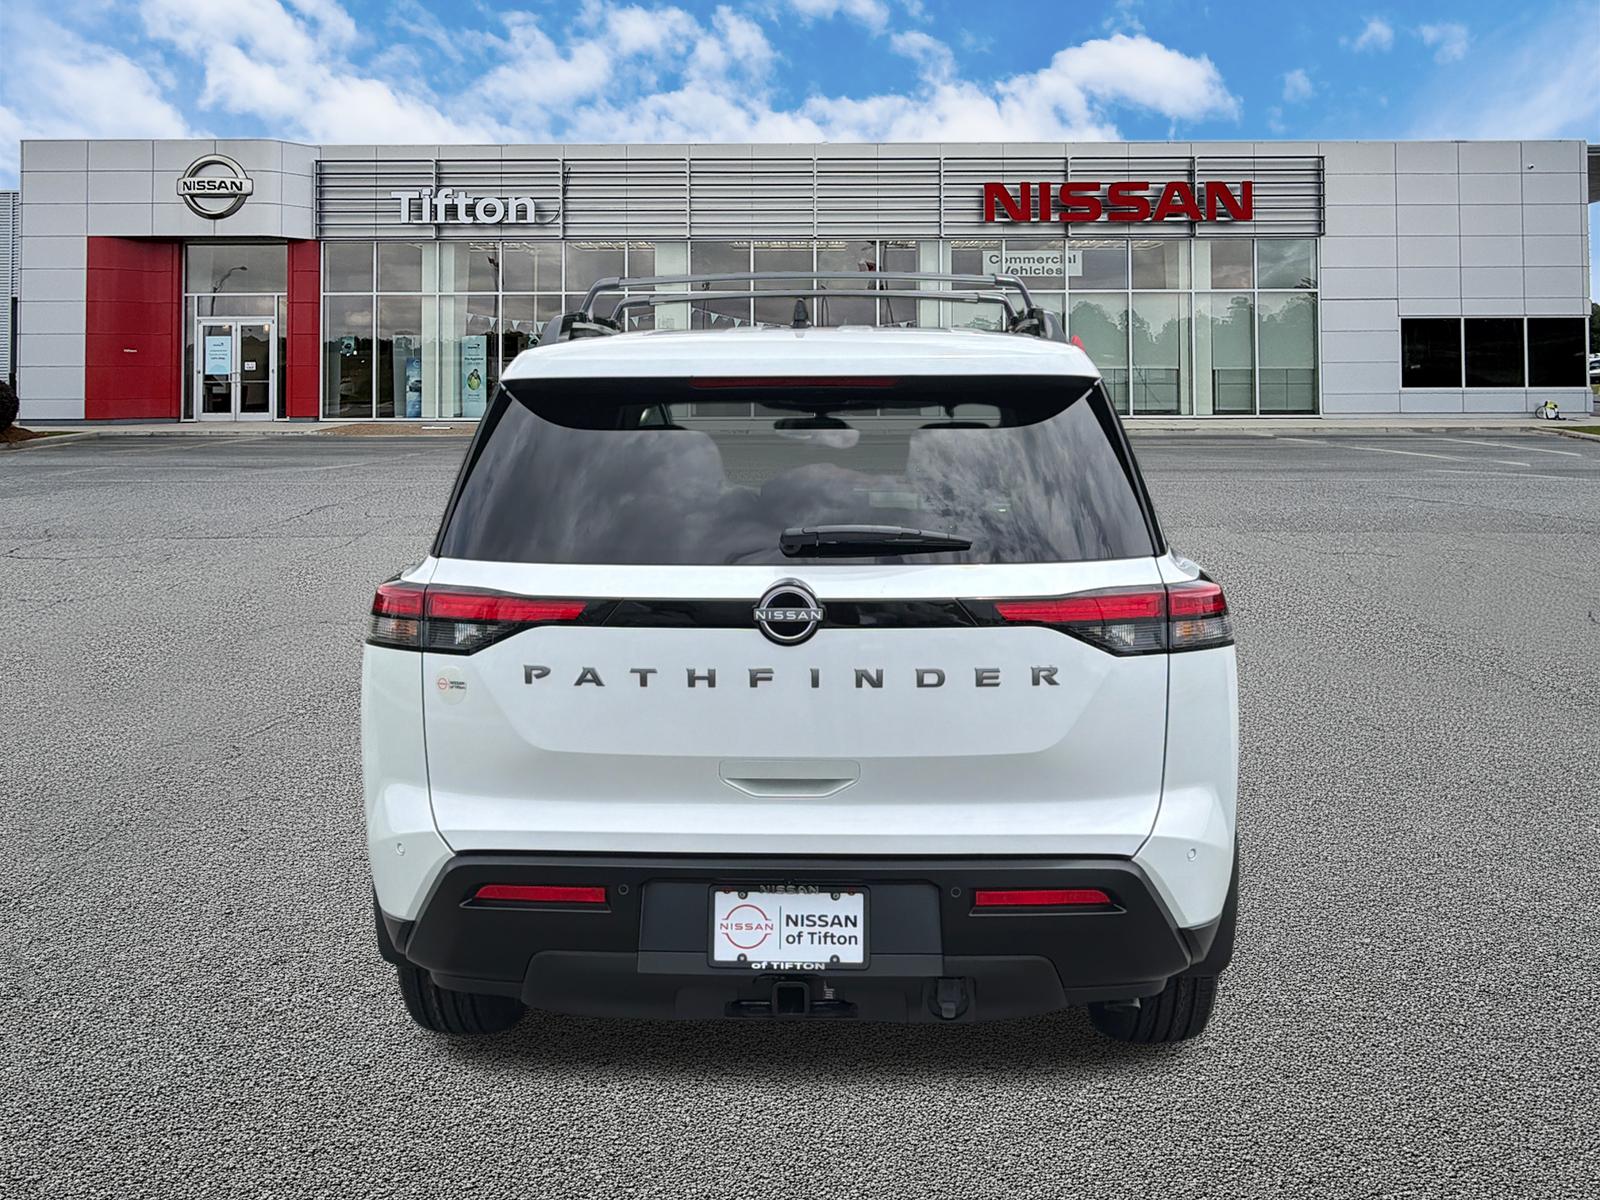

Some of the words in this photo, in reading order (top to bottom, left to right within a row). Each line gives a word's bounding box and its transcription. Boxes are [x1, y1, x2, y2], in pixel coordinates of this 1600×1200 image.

[182, 180, 243, 191] NISSAN
[391, 188, 536, 224] Tifton
[984, 181, 1254, 222] NISSAN
[755, 610, 822, 620] NISSAN
[523, 663, 1061, 689] PATHFINDER
[759, 885, 820, 895] NISSAN
[720, 922, 774, 931] NISSAN
[785, 914, 858, 928] NISSAN
[785, 931, 804, 945] of
[807, 931, 858, 945] Tifton
[751, 961, 768, 970] of
[771, 962, 826, 970] TIFTON
